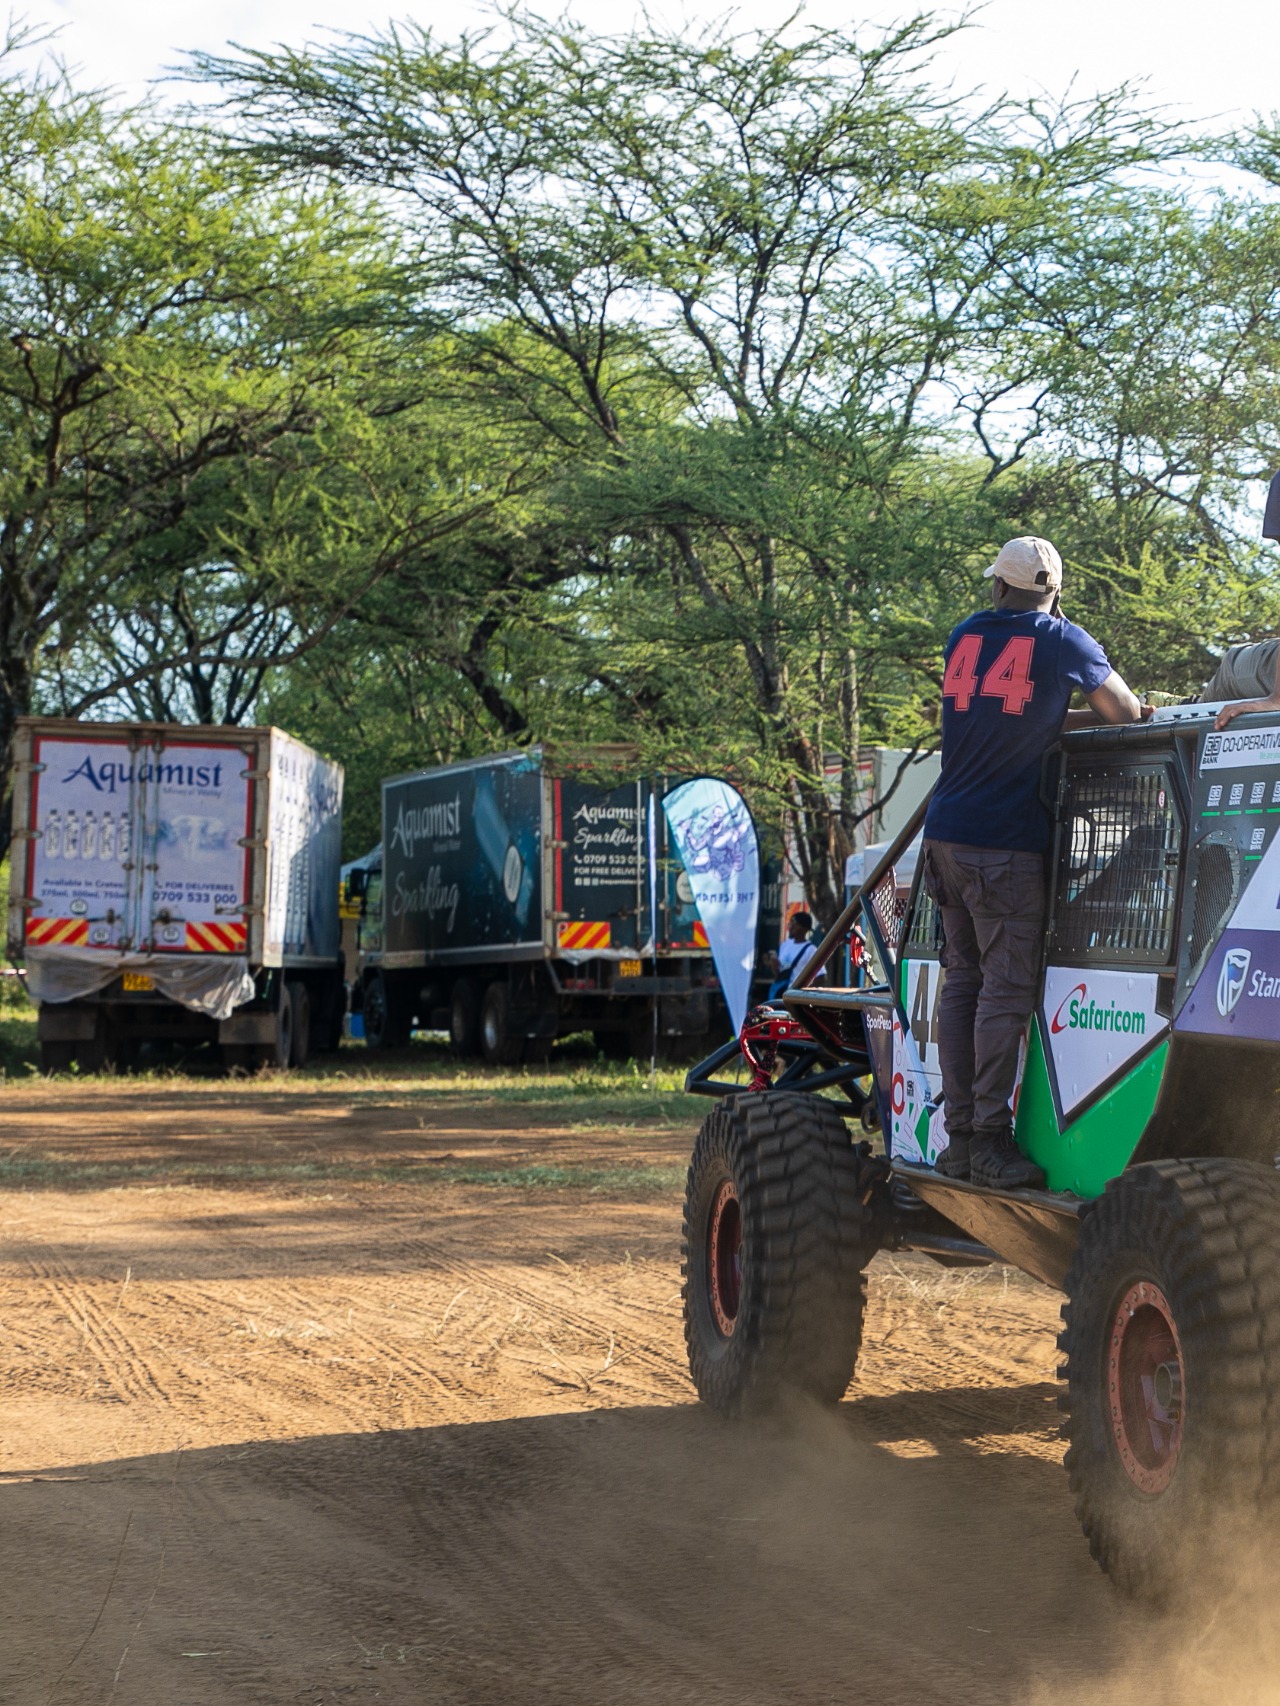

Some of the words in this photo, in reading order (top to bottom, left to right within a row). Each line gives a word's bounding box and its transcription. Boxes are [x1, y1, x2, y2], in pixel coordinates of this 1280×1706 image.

[943, 634, 1035, 715] 44
[62, 755, 222, 793] Aquamist
[390, 790, 461, 858] Aquamist
[583, 854, 607, 864] 0709
[611, 867, 646, 875] DELIVEY
[165, 881, 183, 889] FOR
[186, 882, 234, 891] DELIVERIES
[152, 891, 183, 902] 0709
[187, 892, 210, 903] 533
[214, 893, 237, 904] 000
[866, 1013, 892, 1032] SportPesa
[1069, 999, 1145, 1034] Safaricom
